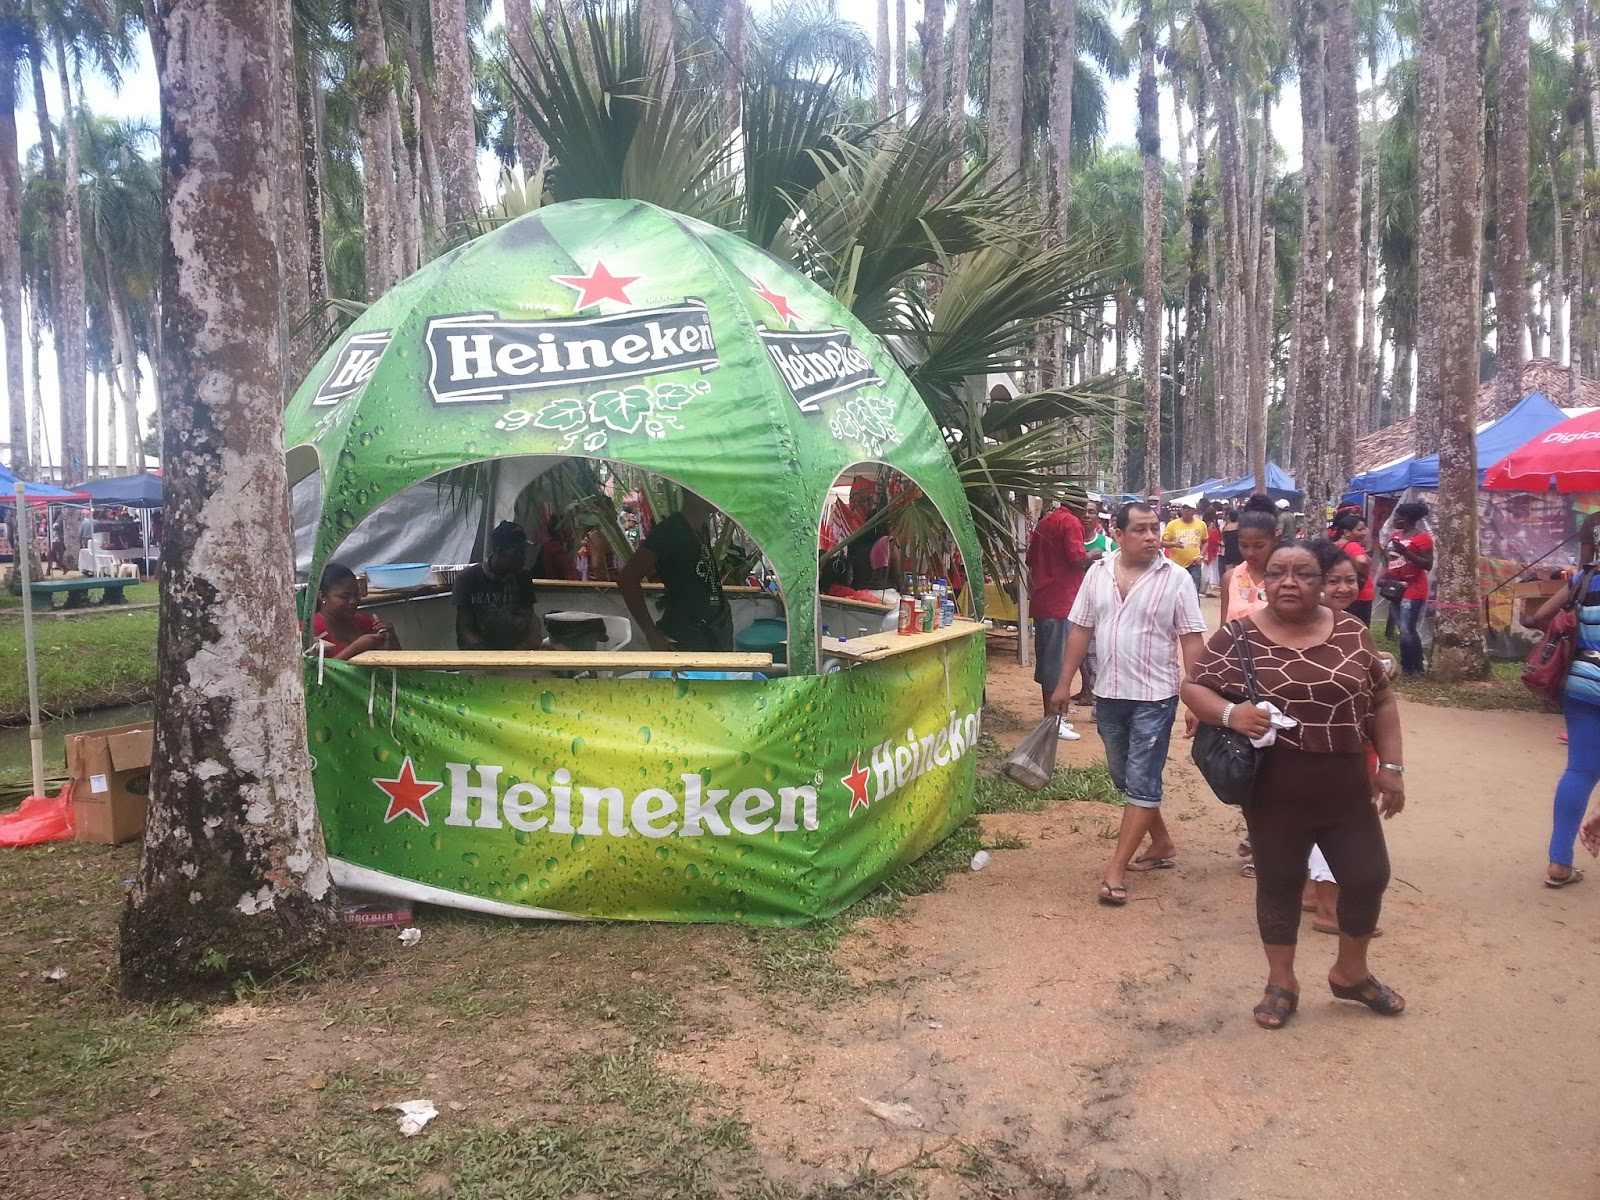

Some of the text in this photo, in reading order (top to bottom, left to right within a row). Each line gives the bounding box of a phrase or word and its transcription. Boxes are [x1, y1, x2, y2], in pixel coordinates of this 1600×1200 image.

[446, 321, 715, 381] Heineken
[767, 341, 872, 391] Heineke
[444, 761, 820, 838] Heineken
[343, 914, 369, 923] ARBO
[371, 912, 394, 922] BIER
